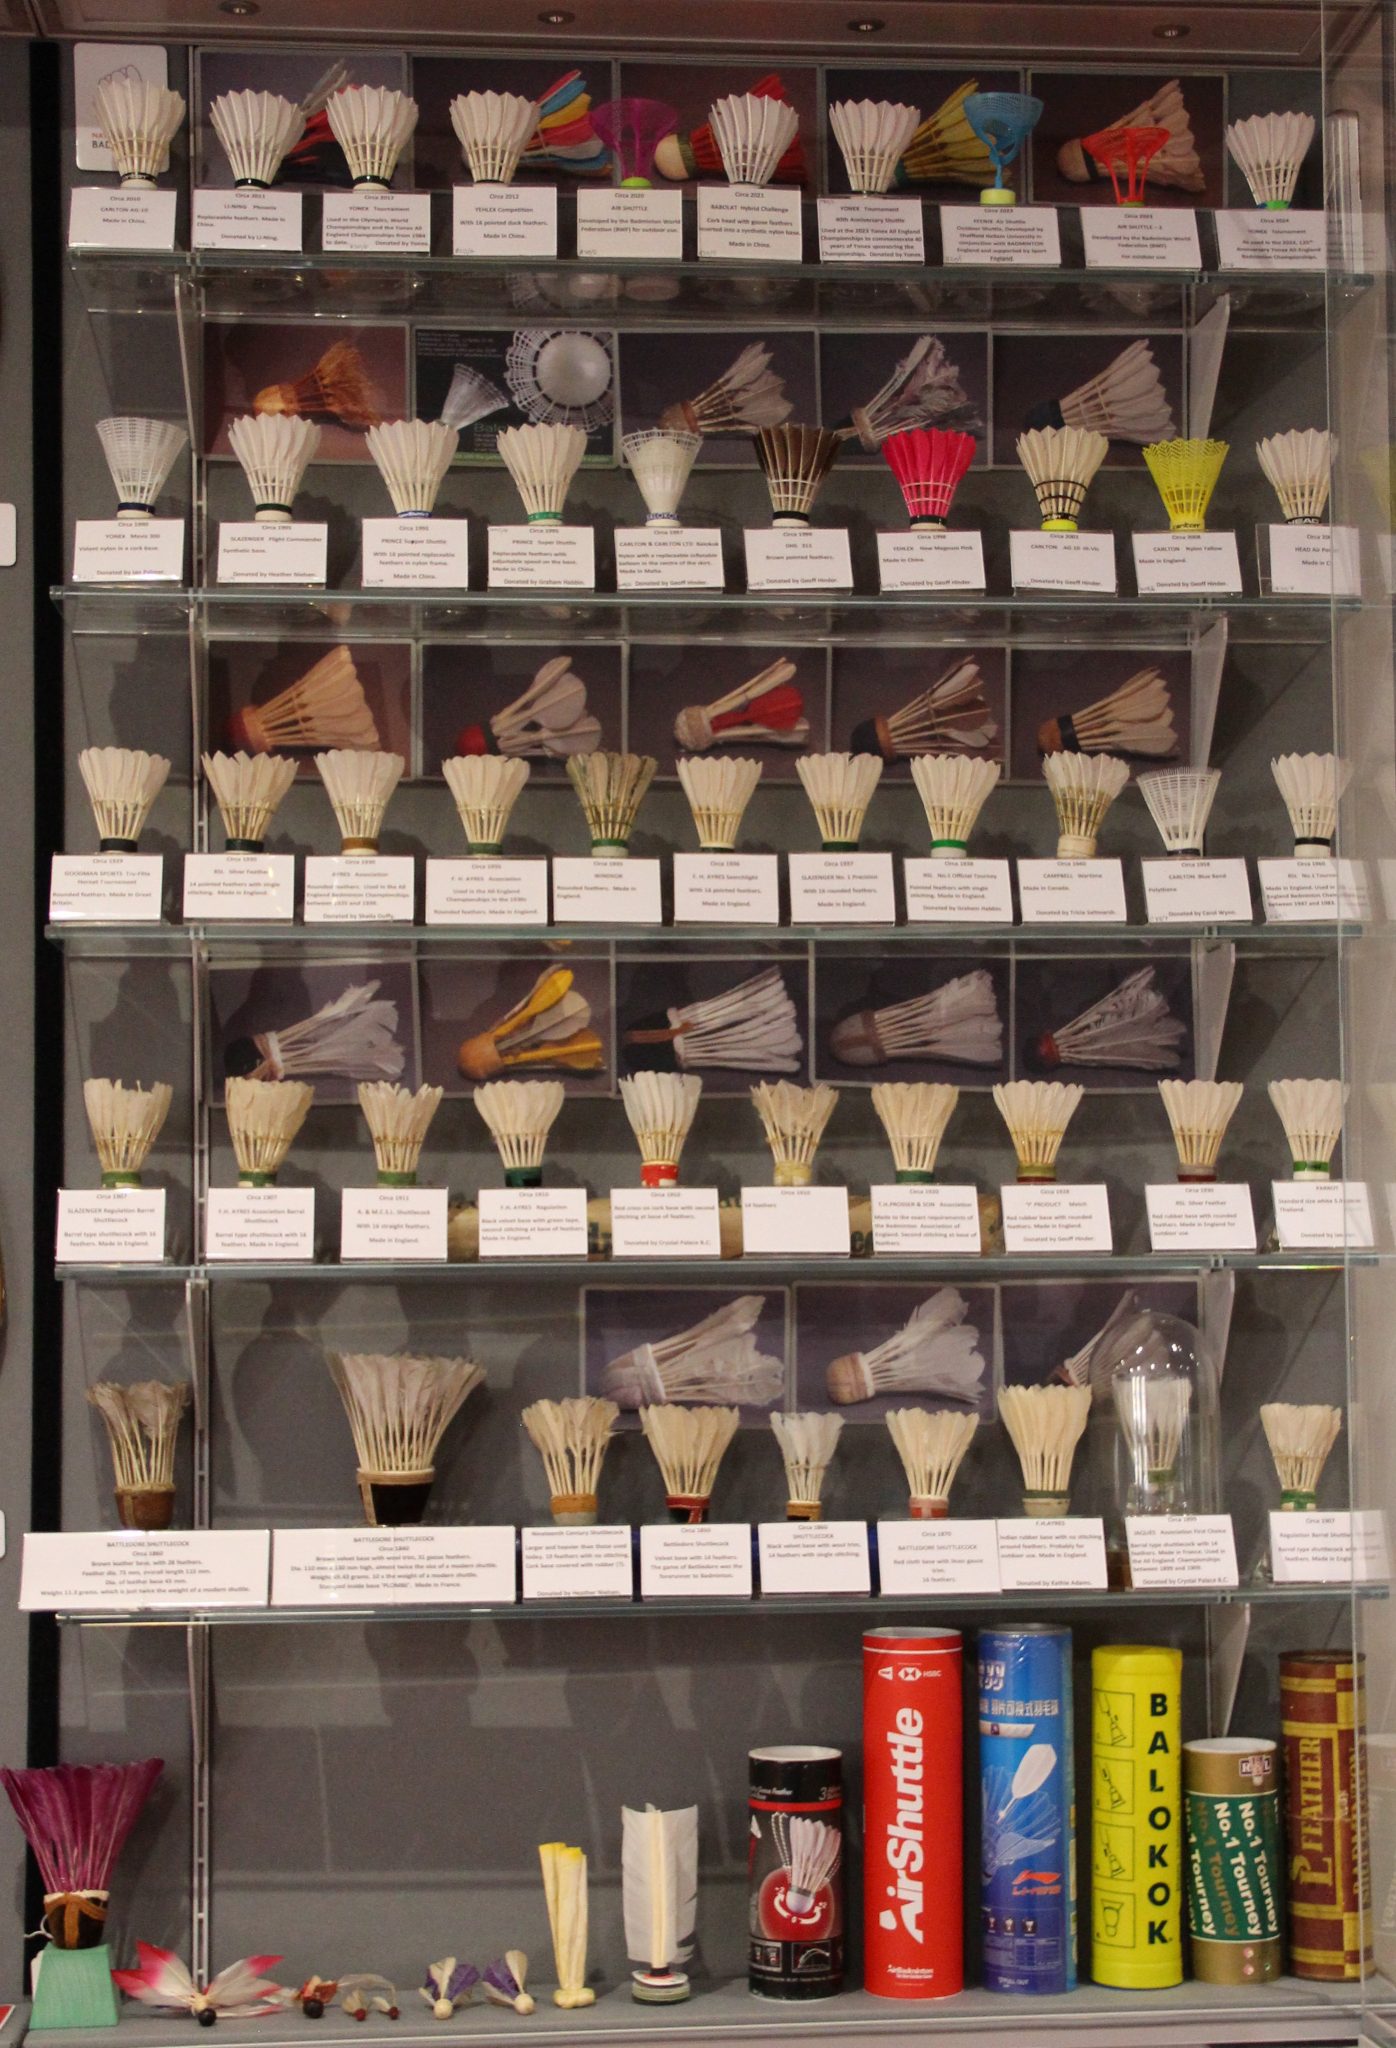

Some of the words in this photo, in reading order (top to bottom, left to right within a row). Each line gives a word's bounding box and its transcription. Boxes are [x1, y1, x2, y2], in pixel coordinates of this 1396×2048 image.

[879, 1707, 923, 1944] AirShuttle
[1230, 1851, 1263, 1936] Tourney
[1253, 1850, 1278, 1933] Tourney
